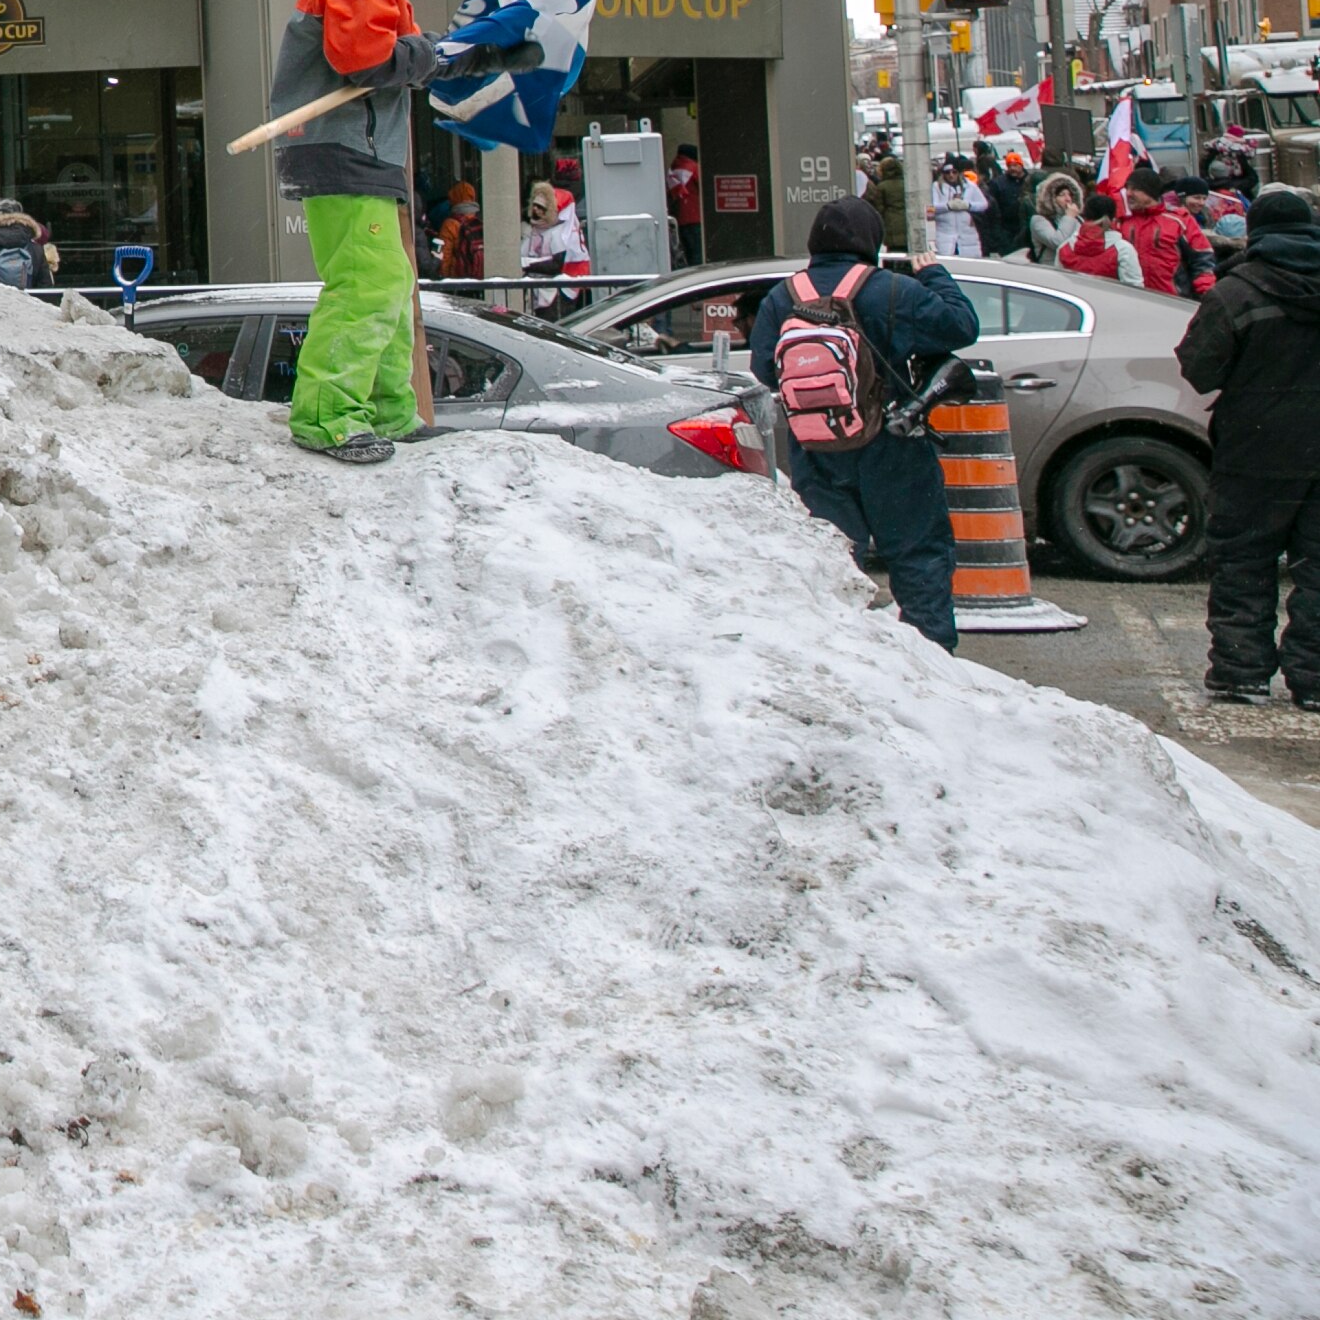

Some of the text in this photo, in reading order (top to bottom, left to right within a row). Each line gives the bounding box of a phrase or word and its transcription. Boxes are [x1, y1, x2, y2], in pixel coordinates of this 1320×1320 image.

[5, 24, 38, 40] CUP
[800, 155, 831, 182] 99
[786, 184, 847, 204] Metcalfe
[706, 305, 738, 318] CON
